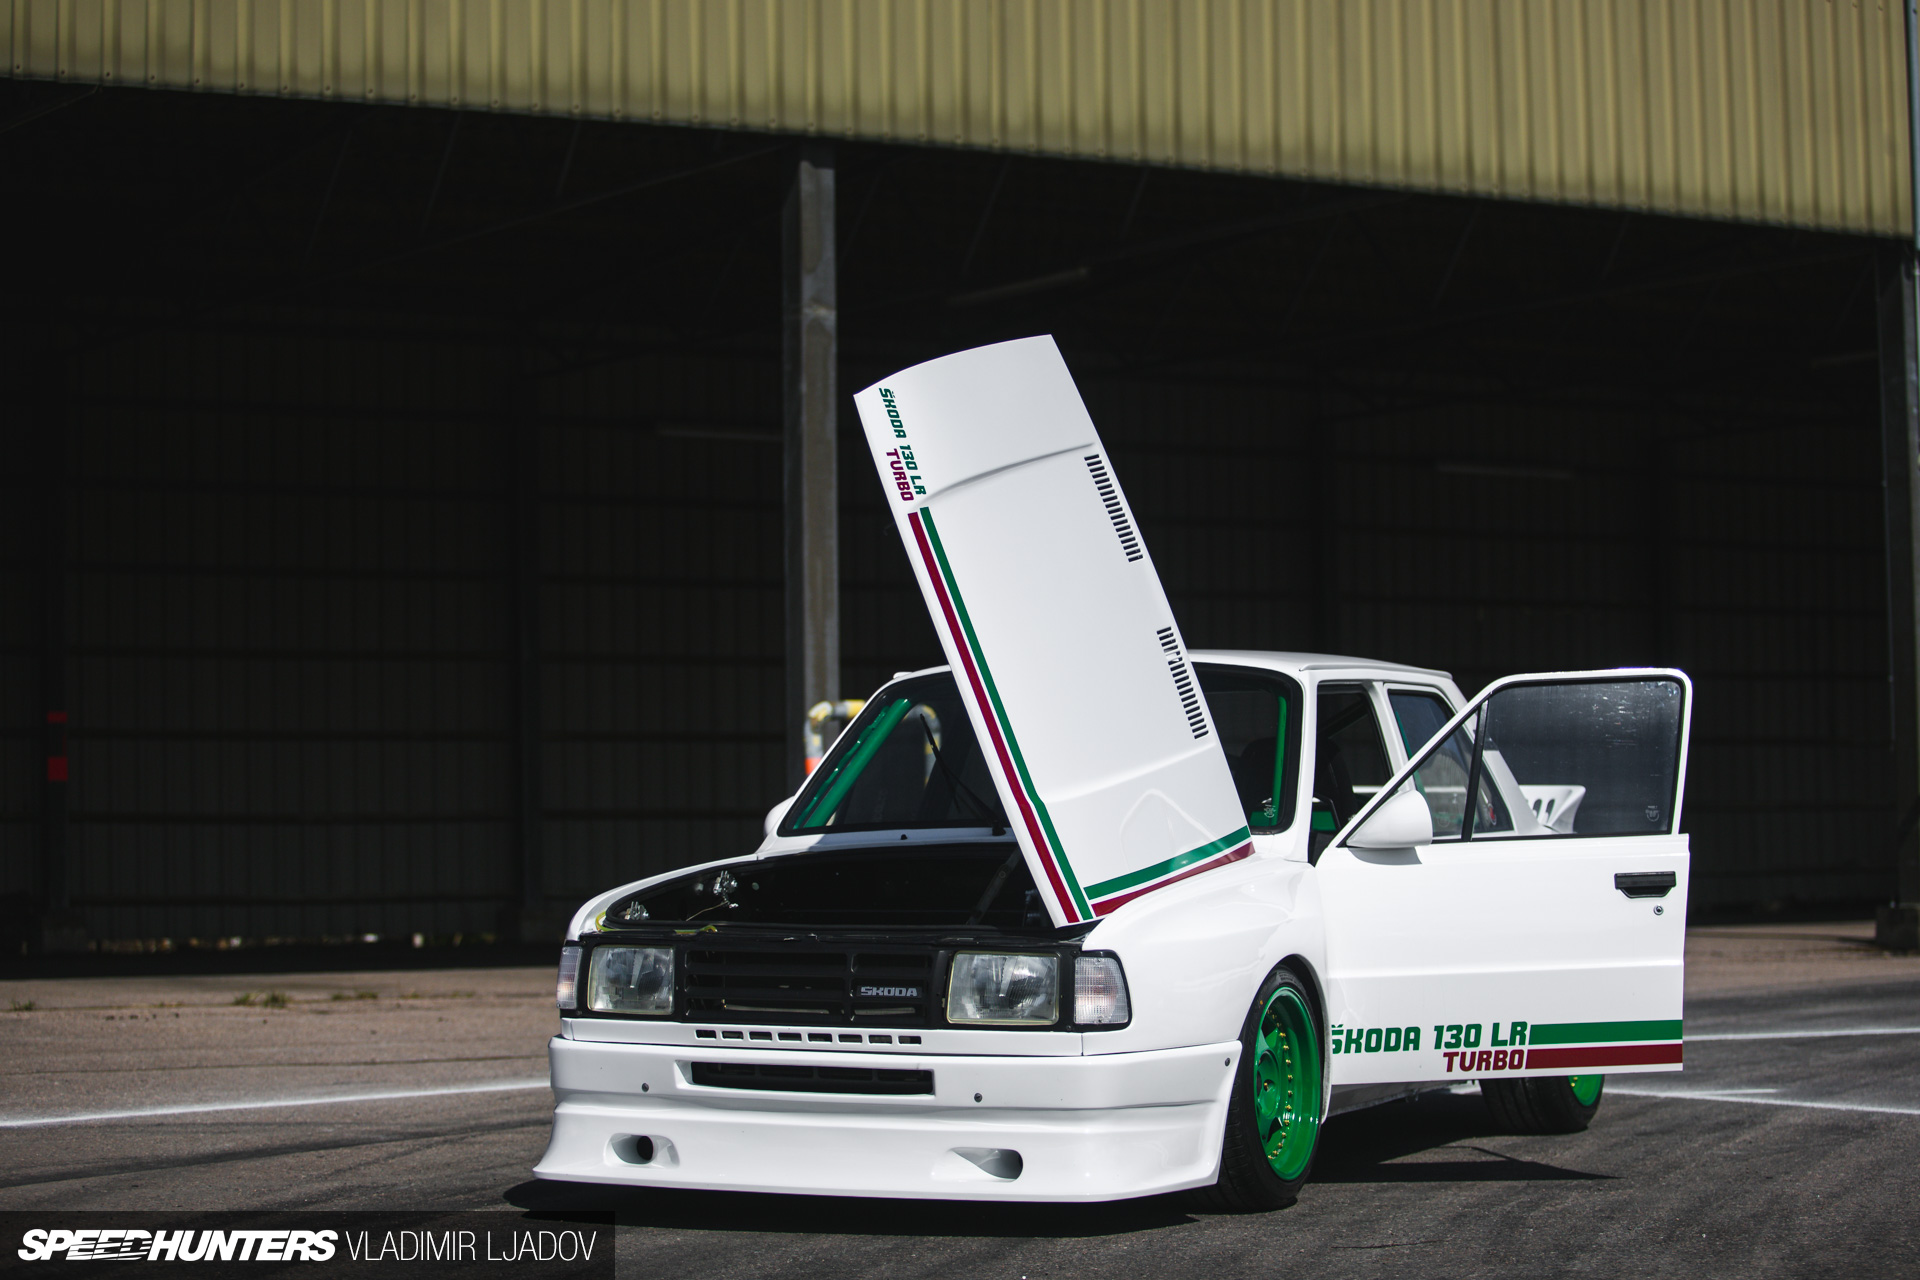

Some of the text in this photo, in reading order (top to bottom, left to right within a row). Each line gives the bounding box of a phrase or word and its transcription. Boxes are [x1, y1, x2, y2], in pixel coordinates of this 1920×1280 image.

[879, 388, 927, 495] ŠKODA 130 LR
[886, 448, 914, 501] TURBO
[1434, 1024, 1482, 1050] 130
[1491, 1021, 1528, 1046] LR
[1443, 1049, 1524, 1072] TURBO
